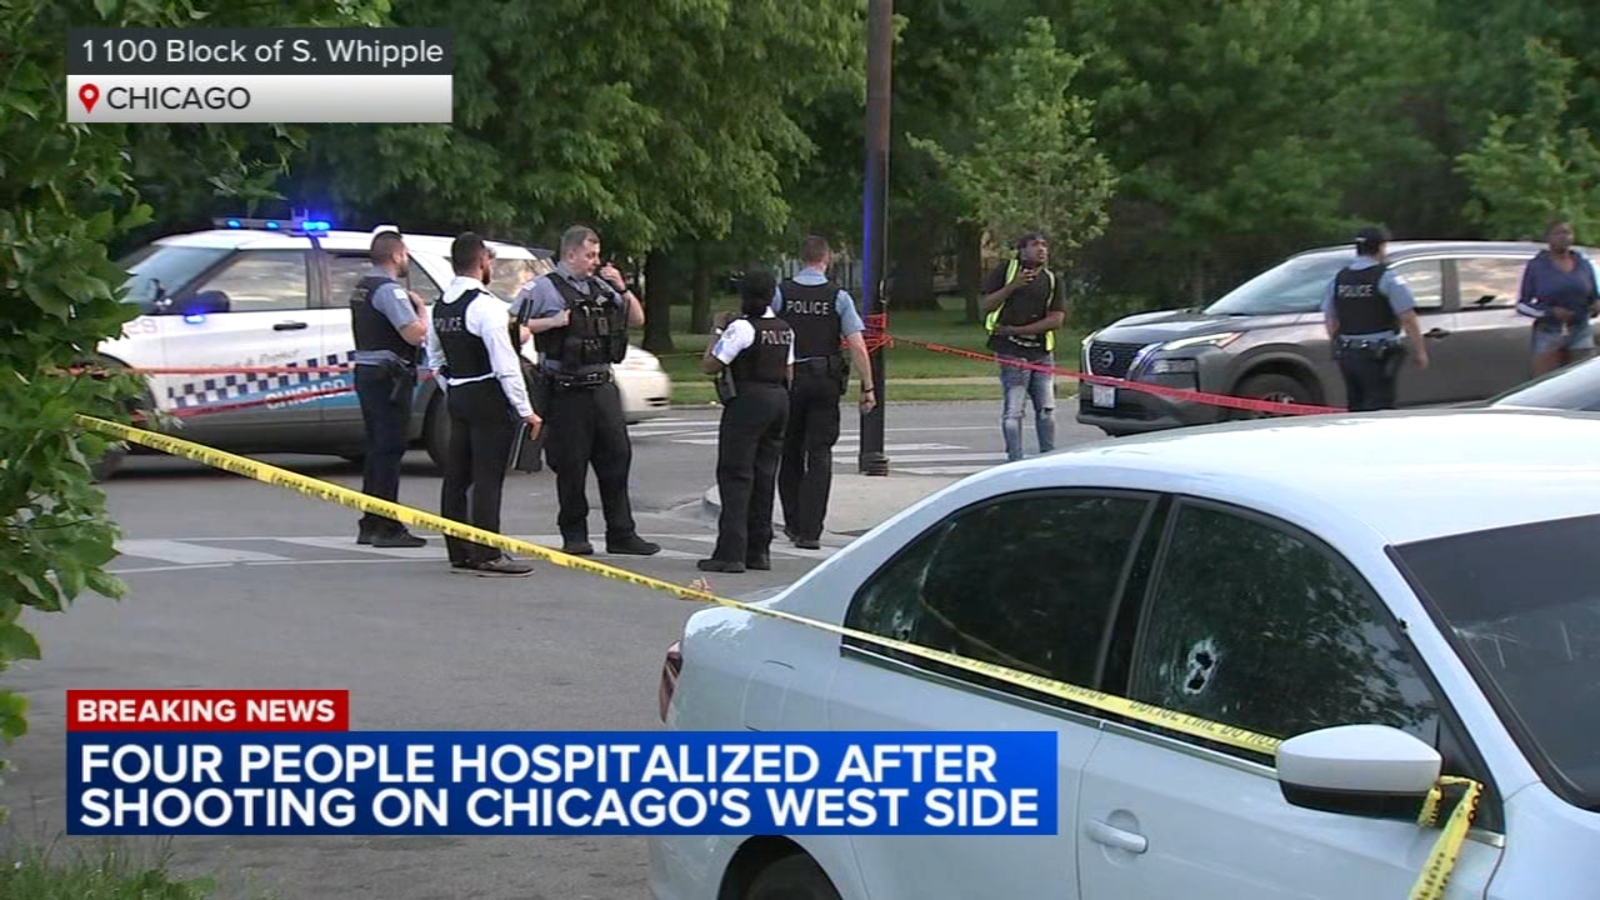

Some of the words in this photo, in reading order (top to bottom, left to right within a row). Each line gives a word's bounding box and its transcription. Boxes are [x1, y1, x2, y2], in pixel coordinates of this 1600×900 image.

[1338, 283, 1374, 298] POLICE
[785, 300, 830, 315] POLICE
[761, 329, 792, 345] POLICE
